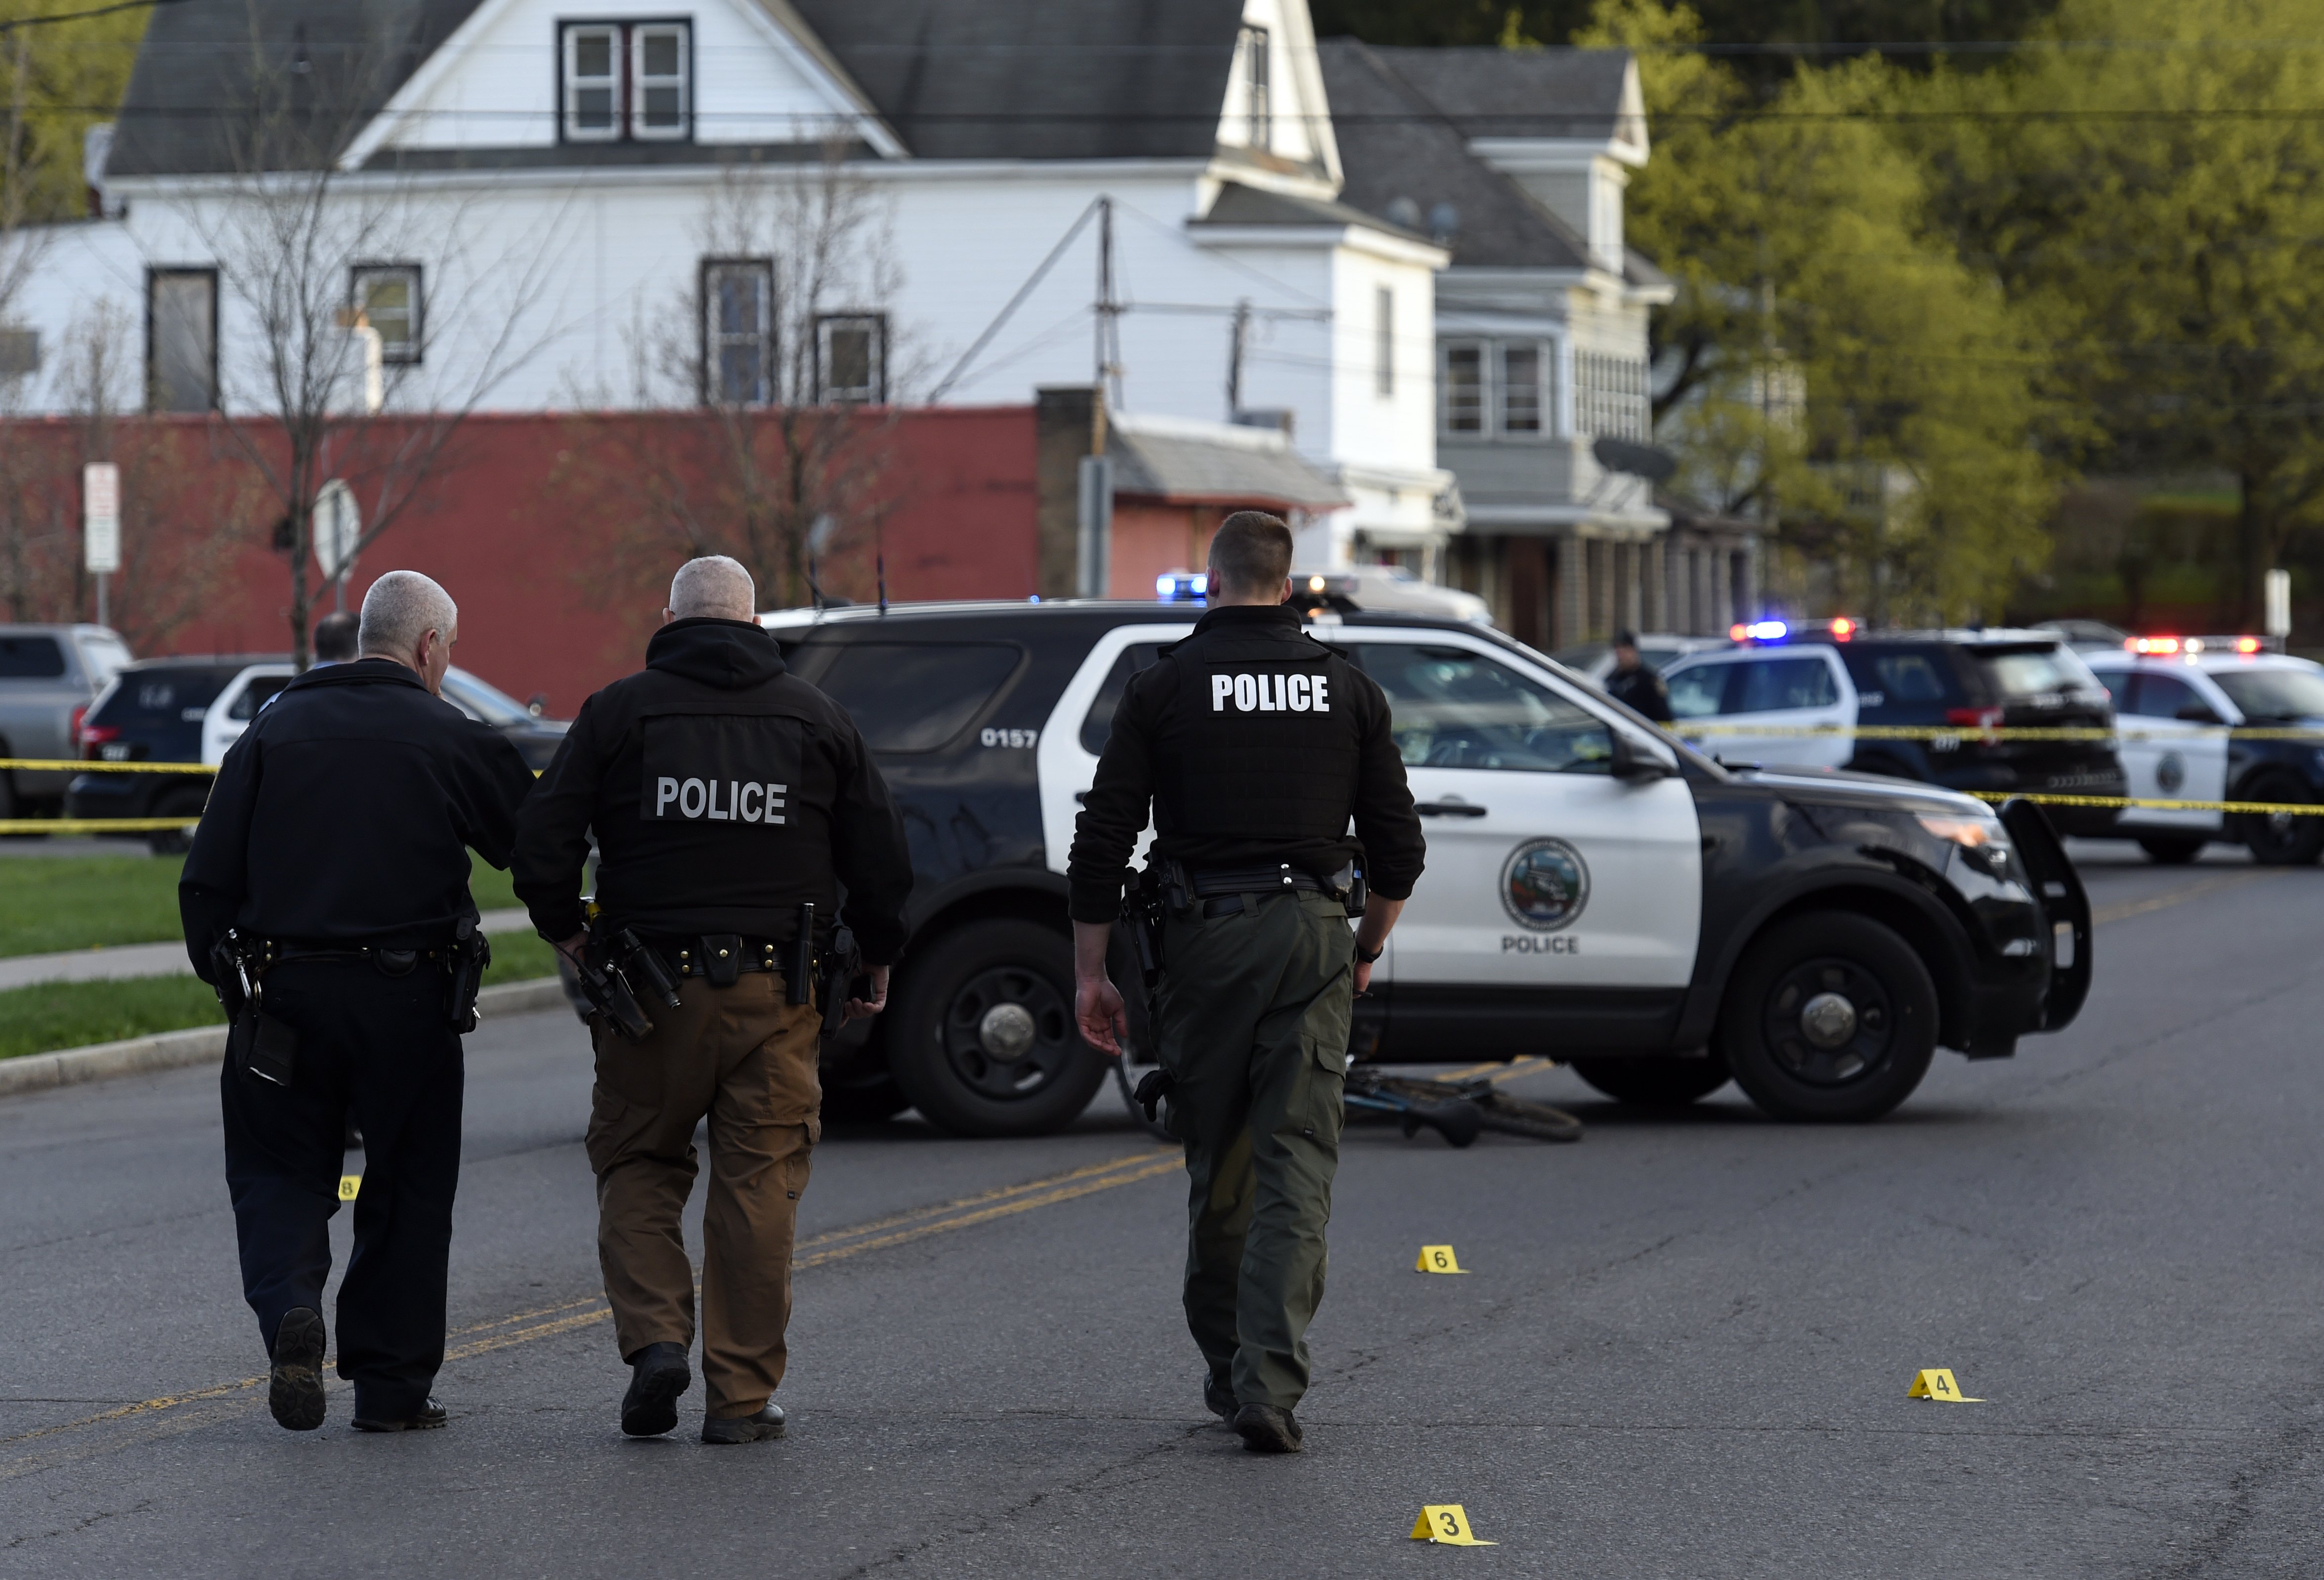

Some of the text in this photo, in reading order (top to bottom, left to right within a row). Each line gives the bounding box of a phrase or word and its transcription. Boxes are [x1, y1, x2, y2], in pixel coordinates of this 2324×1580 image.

[1211, 674, 1329, 712] POLICE
[981, 727, 1038, 749] 0157
[656, 777, 787, 824] POLICE
[1501, 935, 1579, 954] POLICE
[342, 1181, 353, 1196] 8
[1434, 1251, 1447, 1268] 6
[1937, 1375, 1950, 1394] 4
[1439, 1512, 1460, 1537] 3
